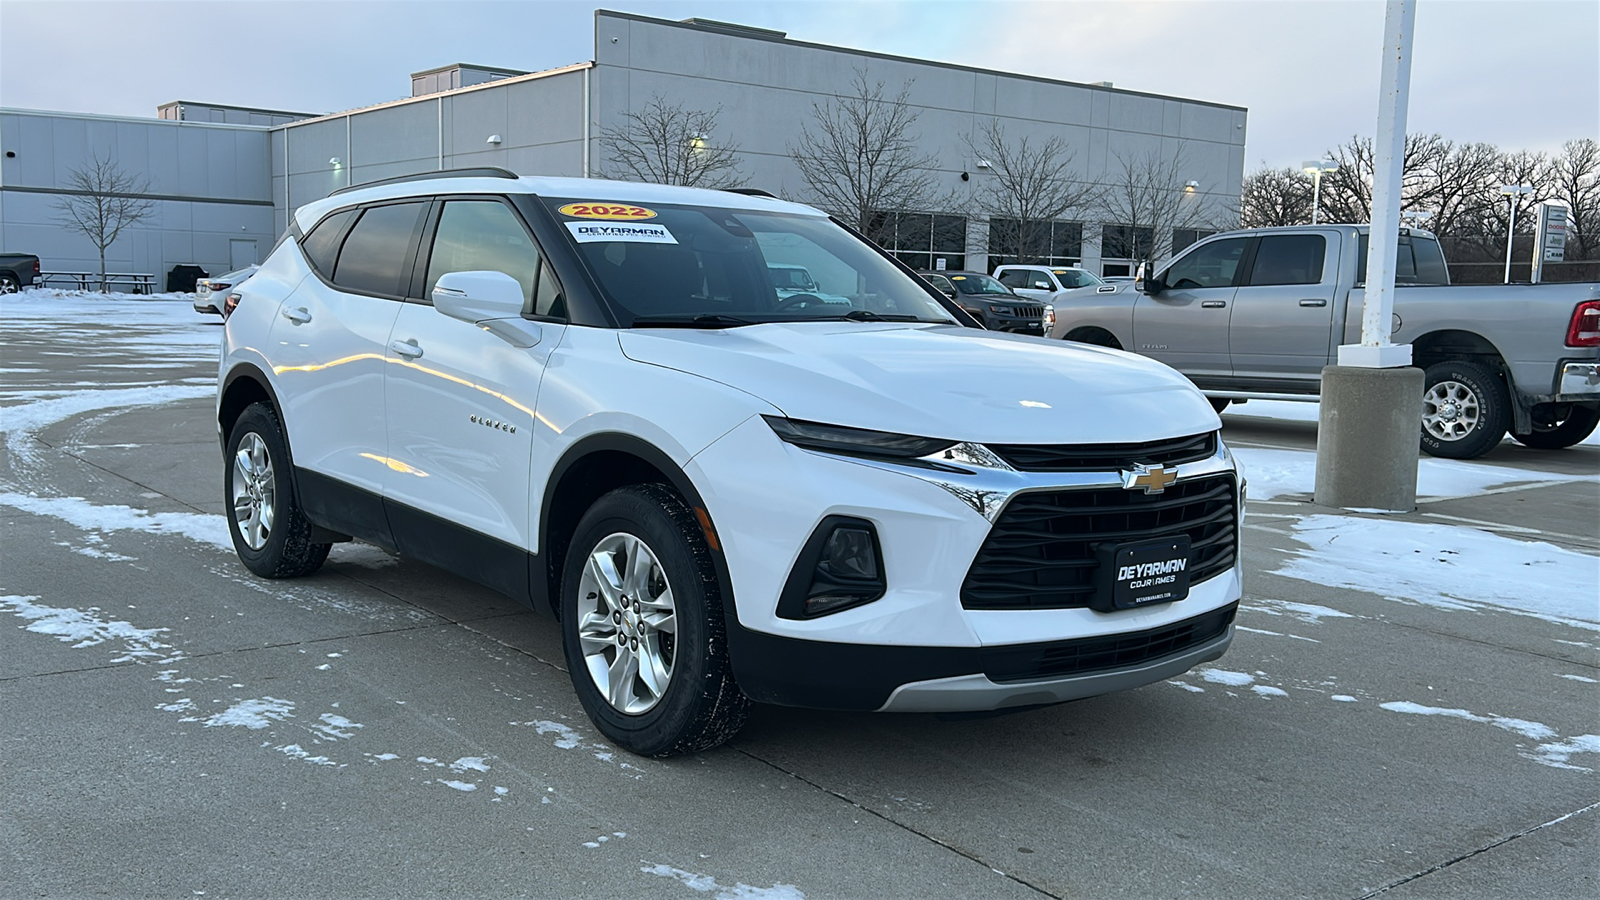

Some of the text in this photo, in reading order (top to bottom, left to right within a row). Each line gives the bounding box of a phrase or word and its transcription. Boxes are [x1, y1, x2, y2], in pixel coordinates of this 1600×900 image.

[572, 205, 648, 217] 2022
[578, 226, 665, 236] DEYARMAN
[1550, 236, 1563, 246] Jeep
[470, 414, 516, 434] BLAZER
[1117, 558, 1187, 581] DEYARMAN
